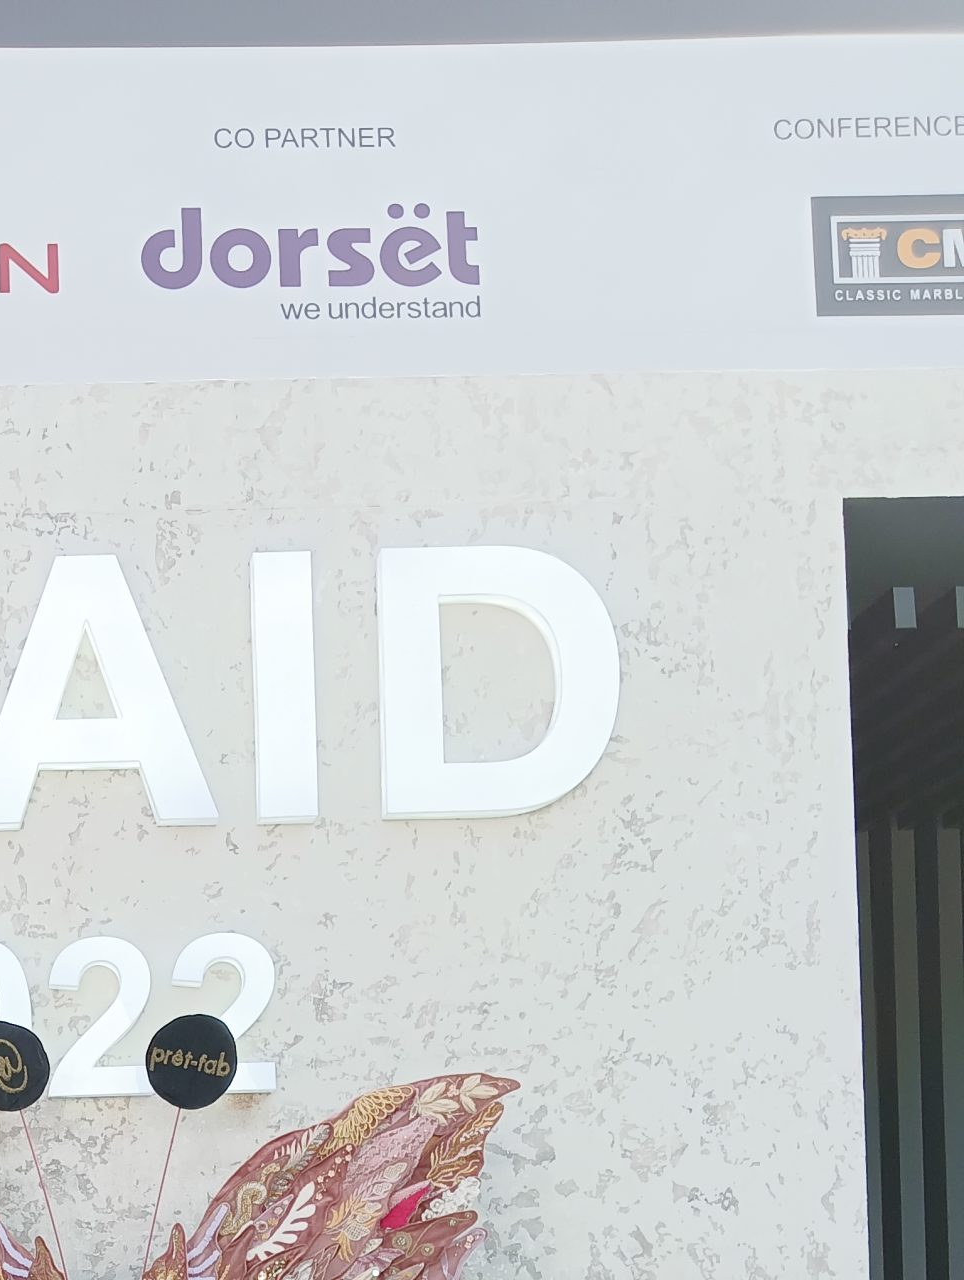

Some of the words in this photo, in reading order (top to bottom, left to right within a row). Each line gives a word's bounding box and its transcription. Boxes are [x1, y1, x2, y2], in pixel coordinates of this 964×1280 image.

[213, 127, 256, 150] CO
[265, 126, 397, 149] PARTNER
[140, 202, 481, 290] dorsët
[279, 302, 321, 321] we
[327, 294, 482, 320] understand
[834, 289, 902, 302] CLASSIC
